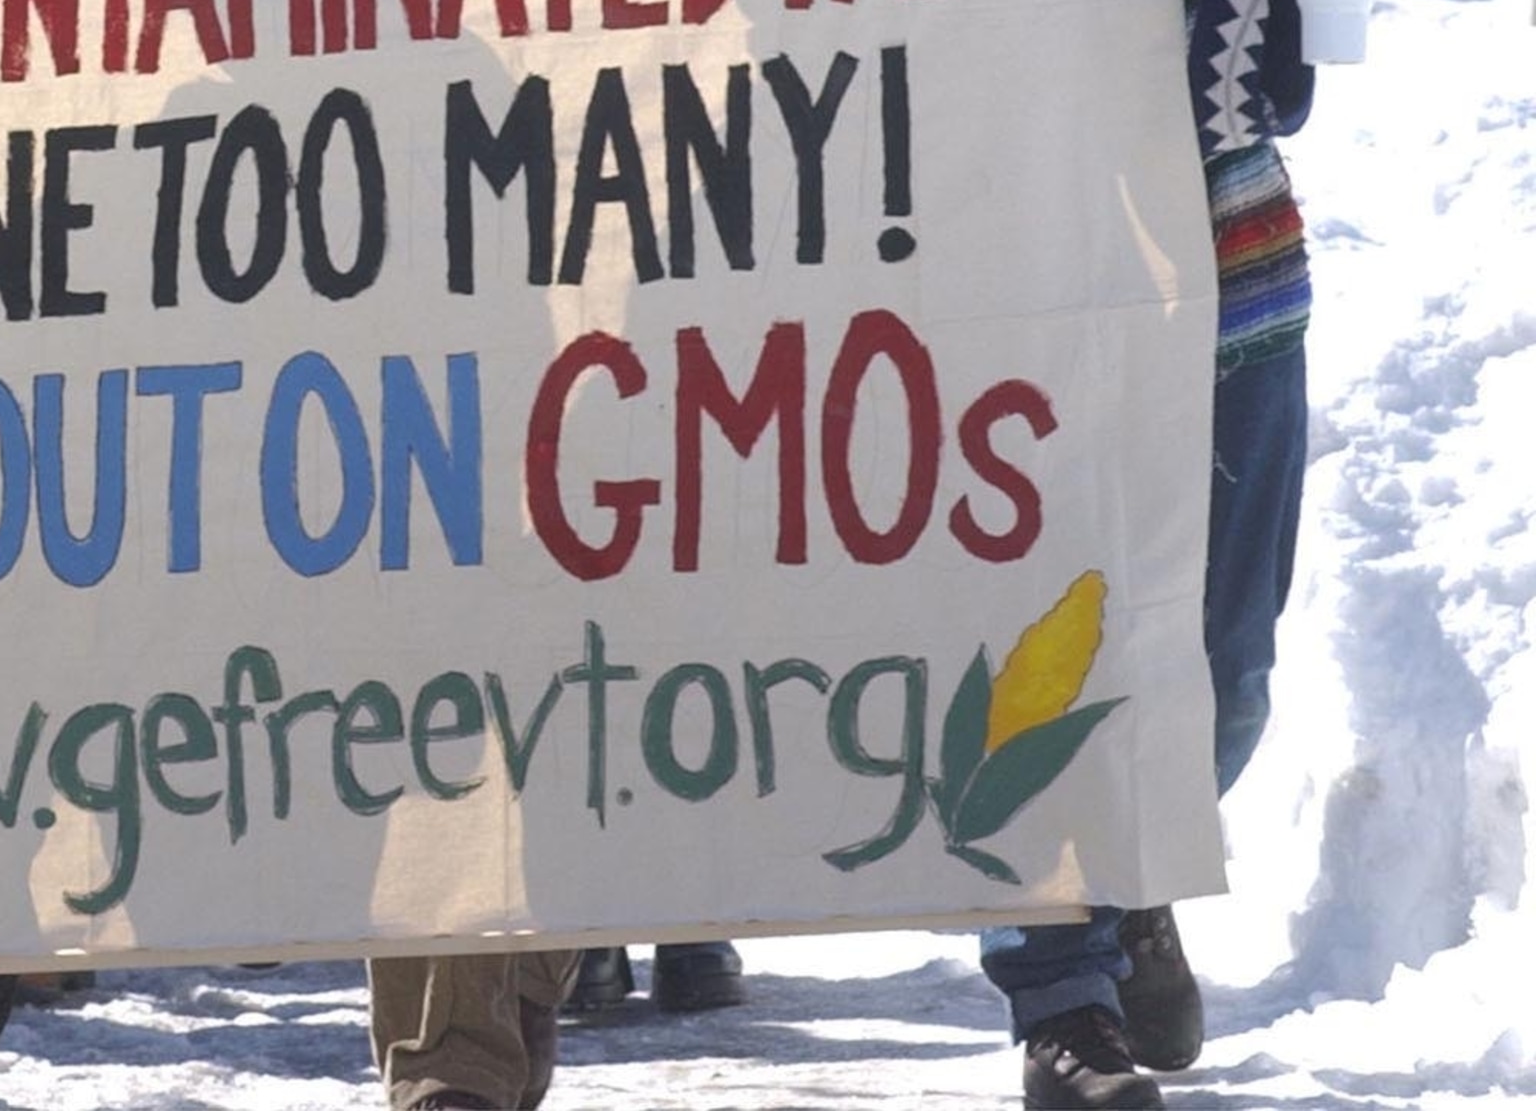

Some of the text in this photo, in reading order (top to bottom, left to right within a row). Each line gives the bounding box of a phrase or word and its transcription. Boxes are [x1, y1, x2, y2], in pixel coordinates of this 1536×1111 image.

[133, 87, 388, 304] TOO
[445, 44, 916, 295] MANY!
[260, 350, 484, 579] ON
[525, 308, 1059, 582] GMOs
